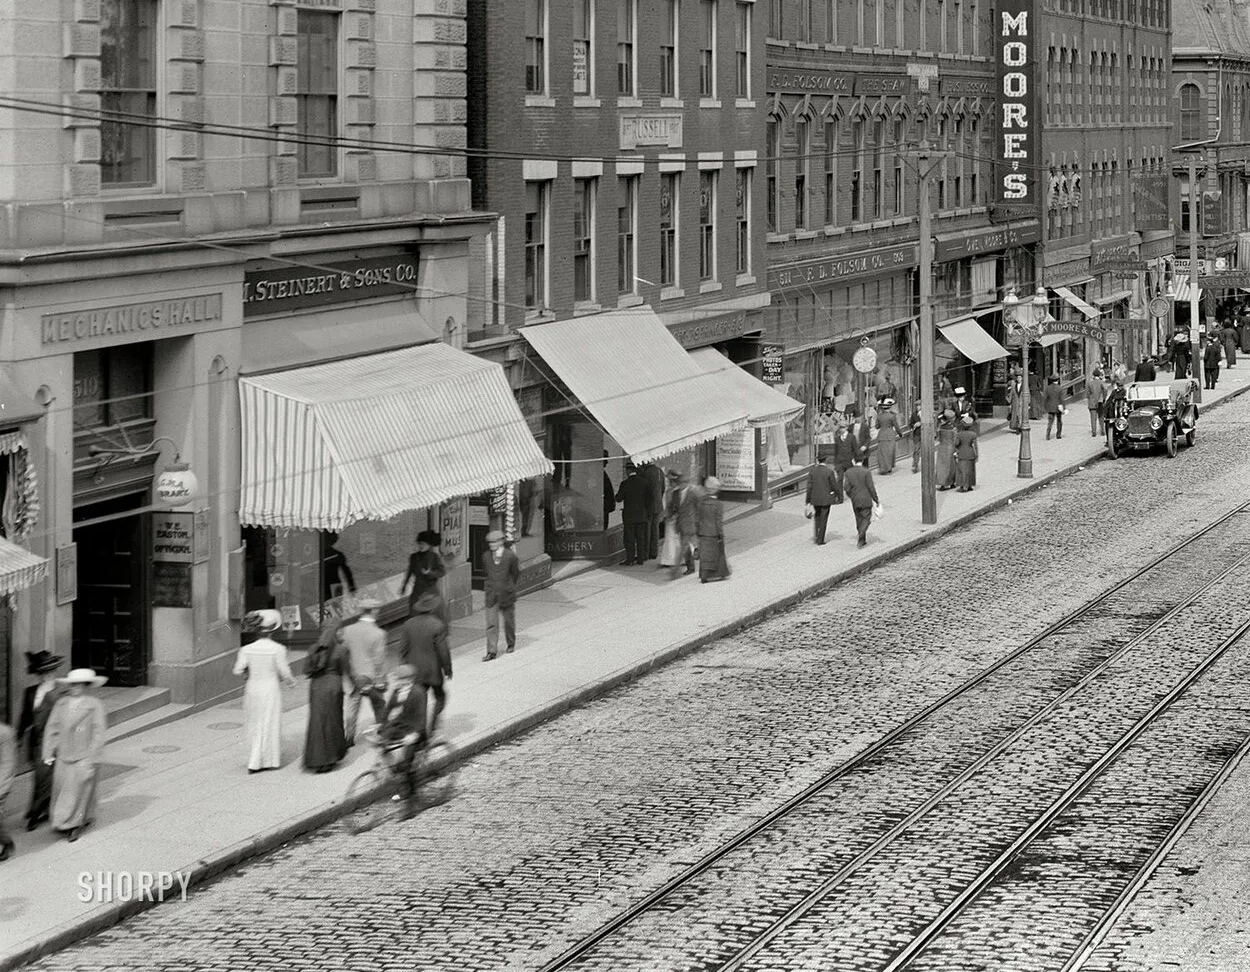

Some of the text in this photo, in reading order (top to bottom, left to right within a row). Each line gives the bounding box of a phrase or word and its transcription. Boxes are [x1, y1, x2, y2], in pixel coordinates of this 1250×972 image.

[1001, 10, 1029, 199] MOORE'S
[831, 257, 867, 277] FOLSOM
[255, 274, 337, 301] STEINERT
[339, 271, 351, 290] &
[354, 267, 392, 288] SONS
[1051, 322, 1080, 333] MOORE
